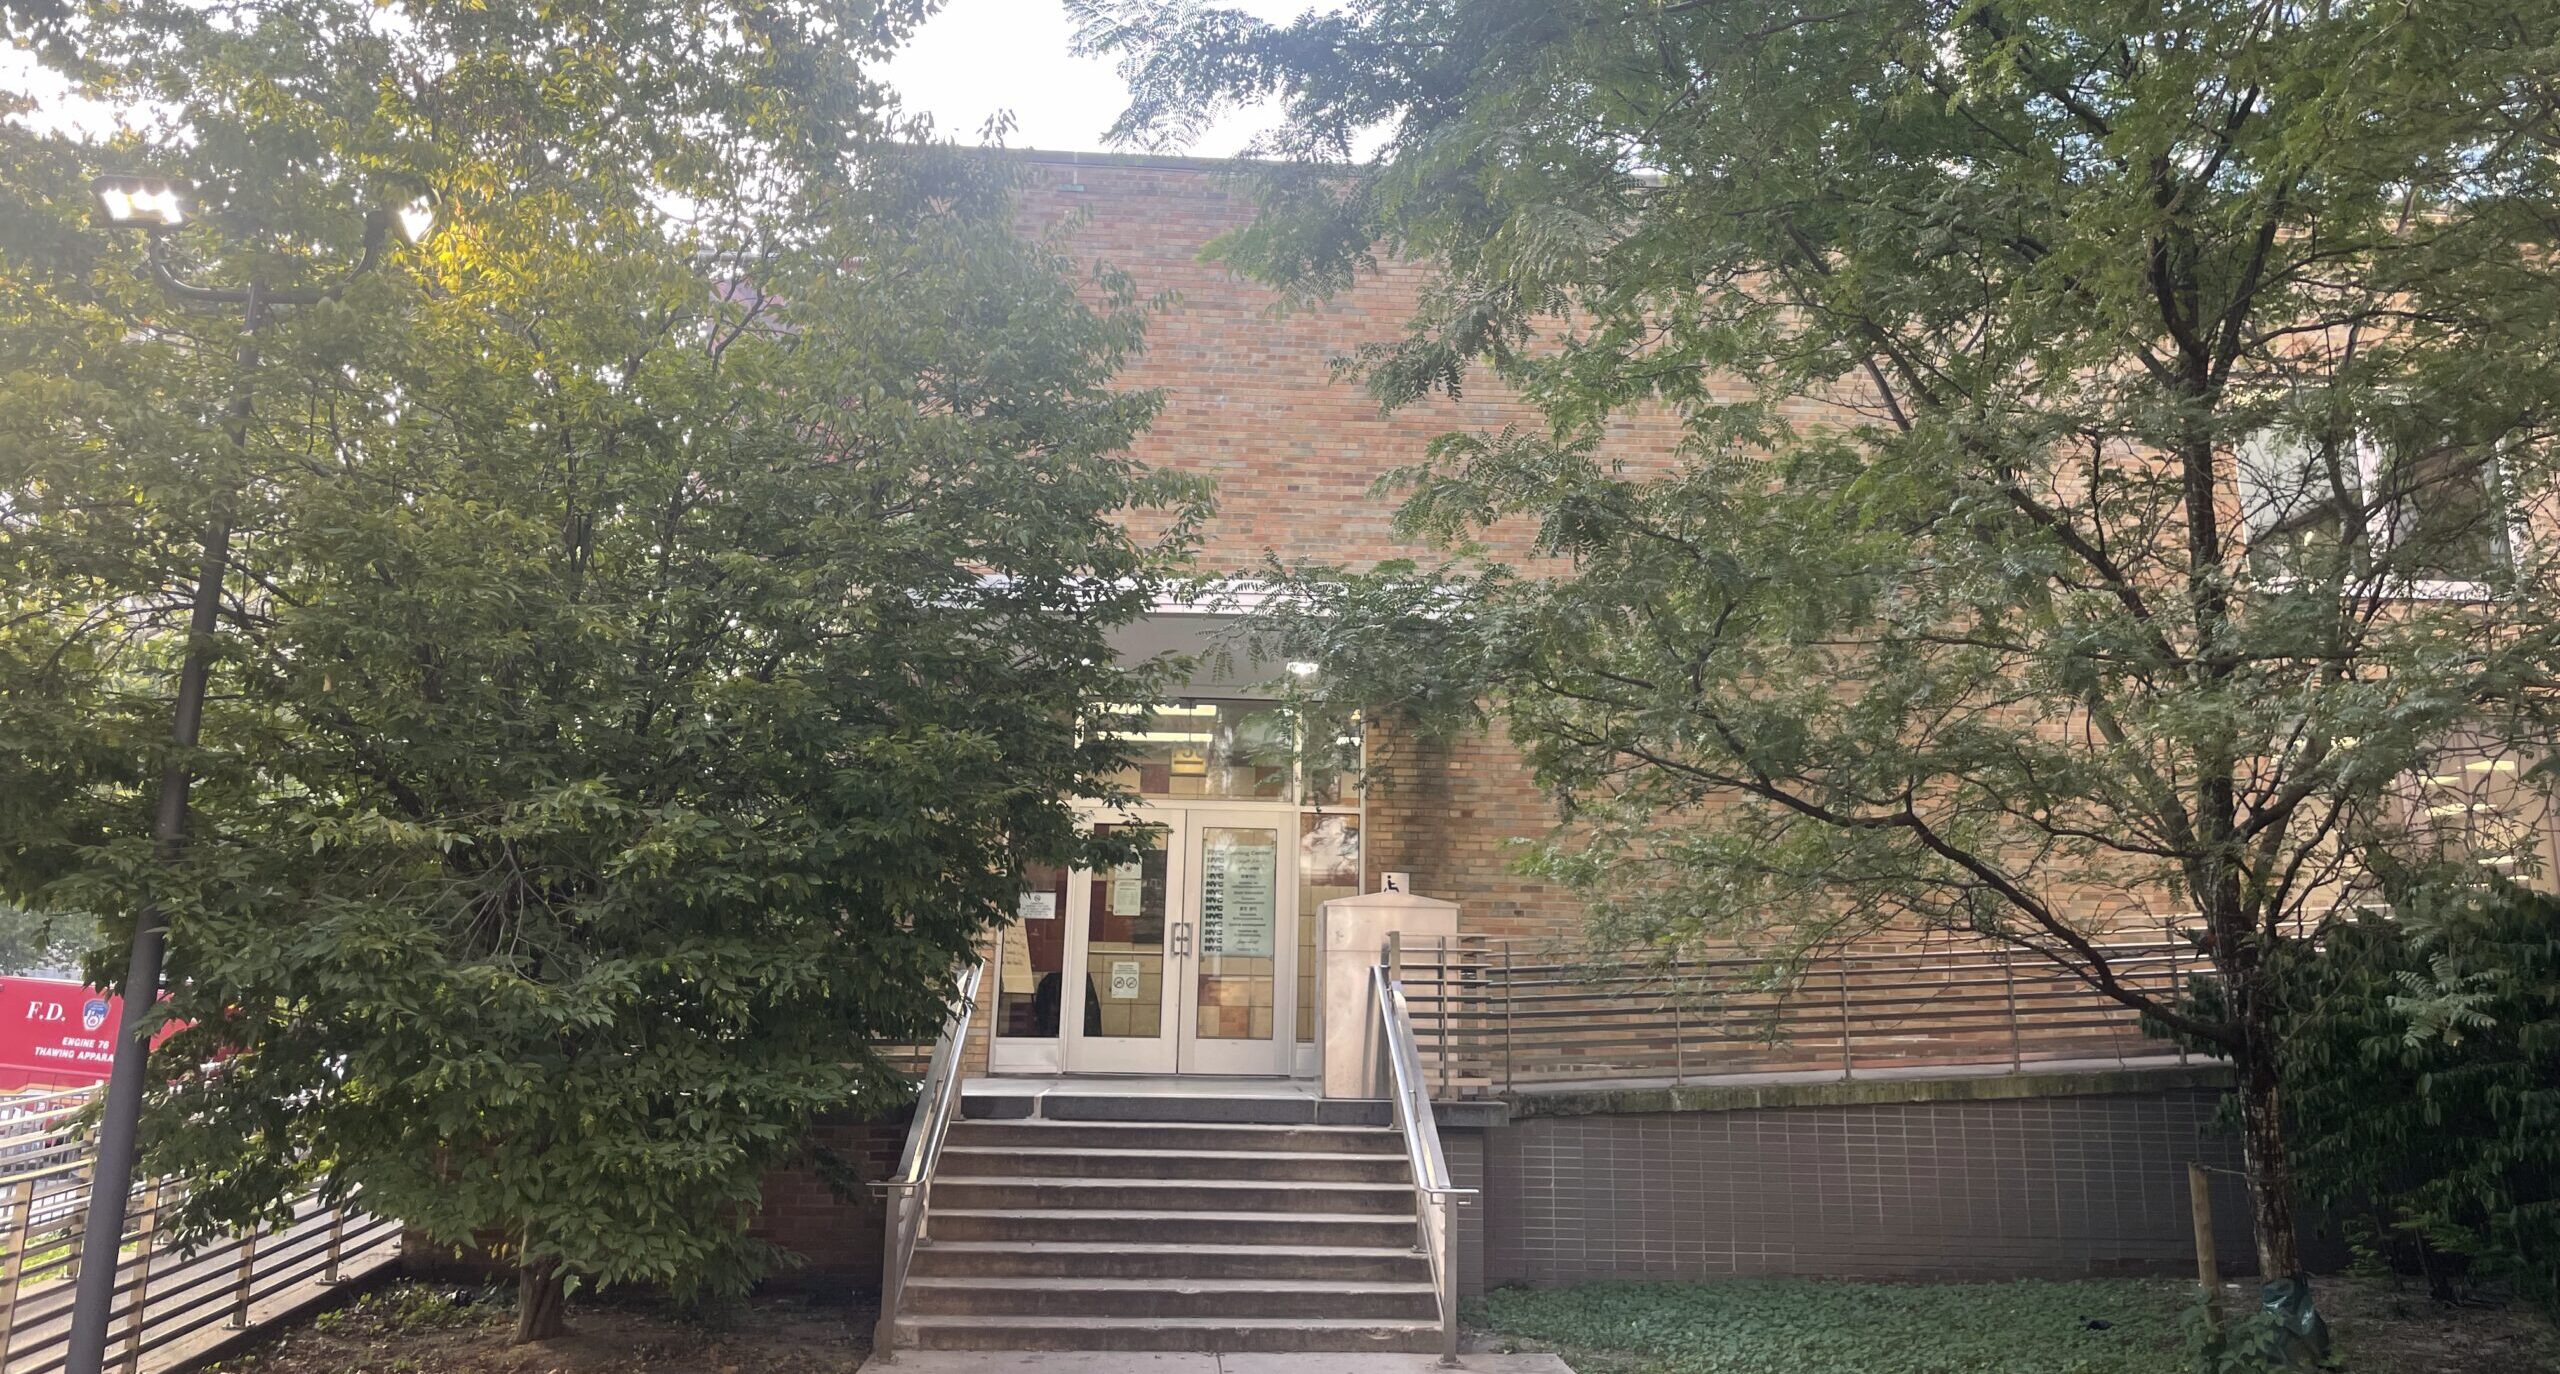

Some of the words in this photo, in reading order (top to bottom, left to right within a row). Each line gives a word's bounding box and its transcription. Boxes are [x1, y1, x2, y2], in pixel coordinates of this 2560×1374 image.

[26, 1001, 66, 1021] F.D.
[62, 1037, 95, 1048] ENGINE
[35, 1047, 75, 1058] THAWING
